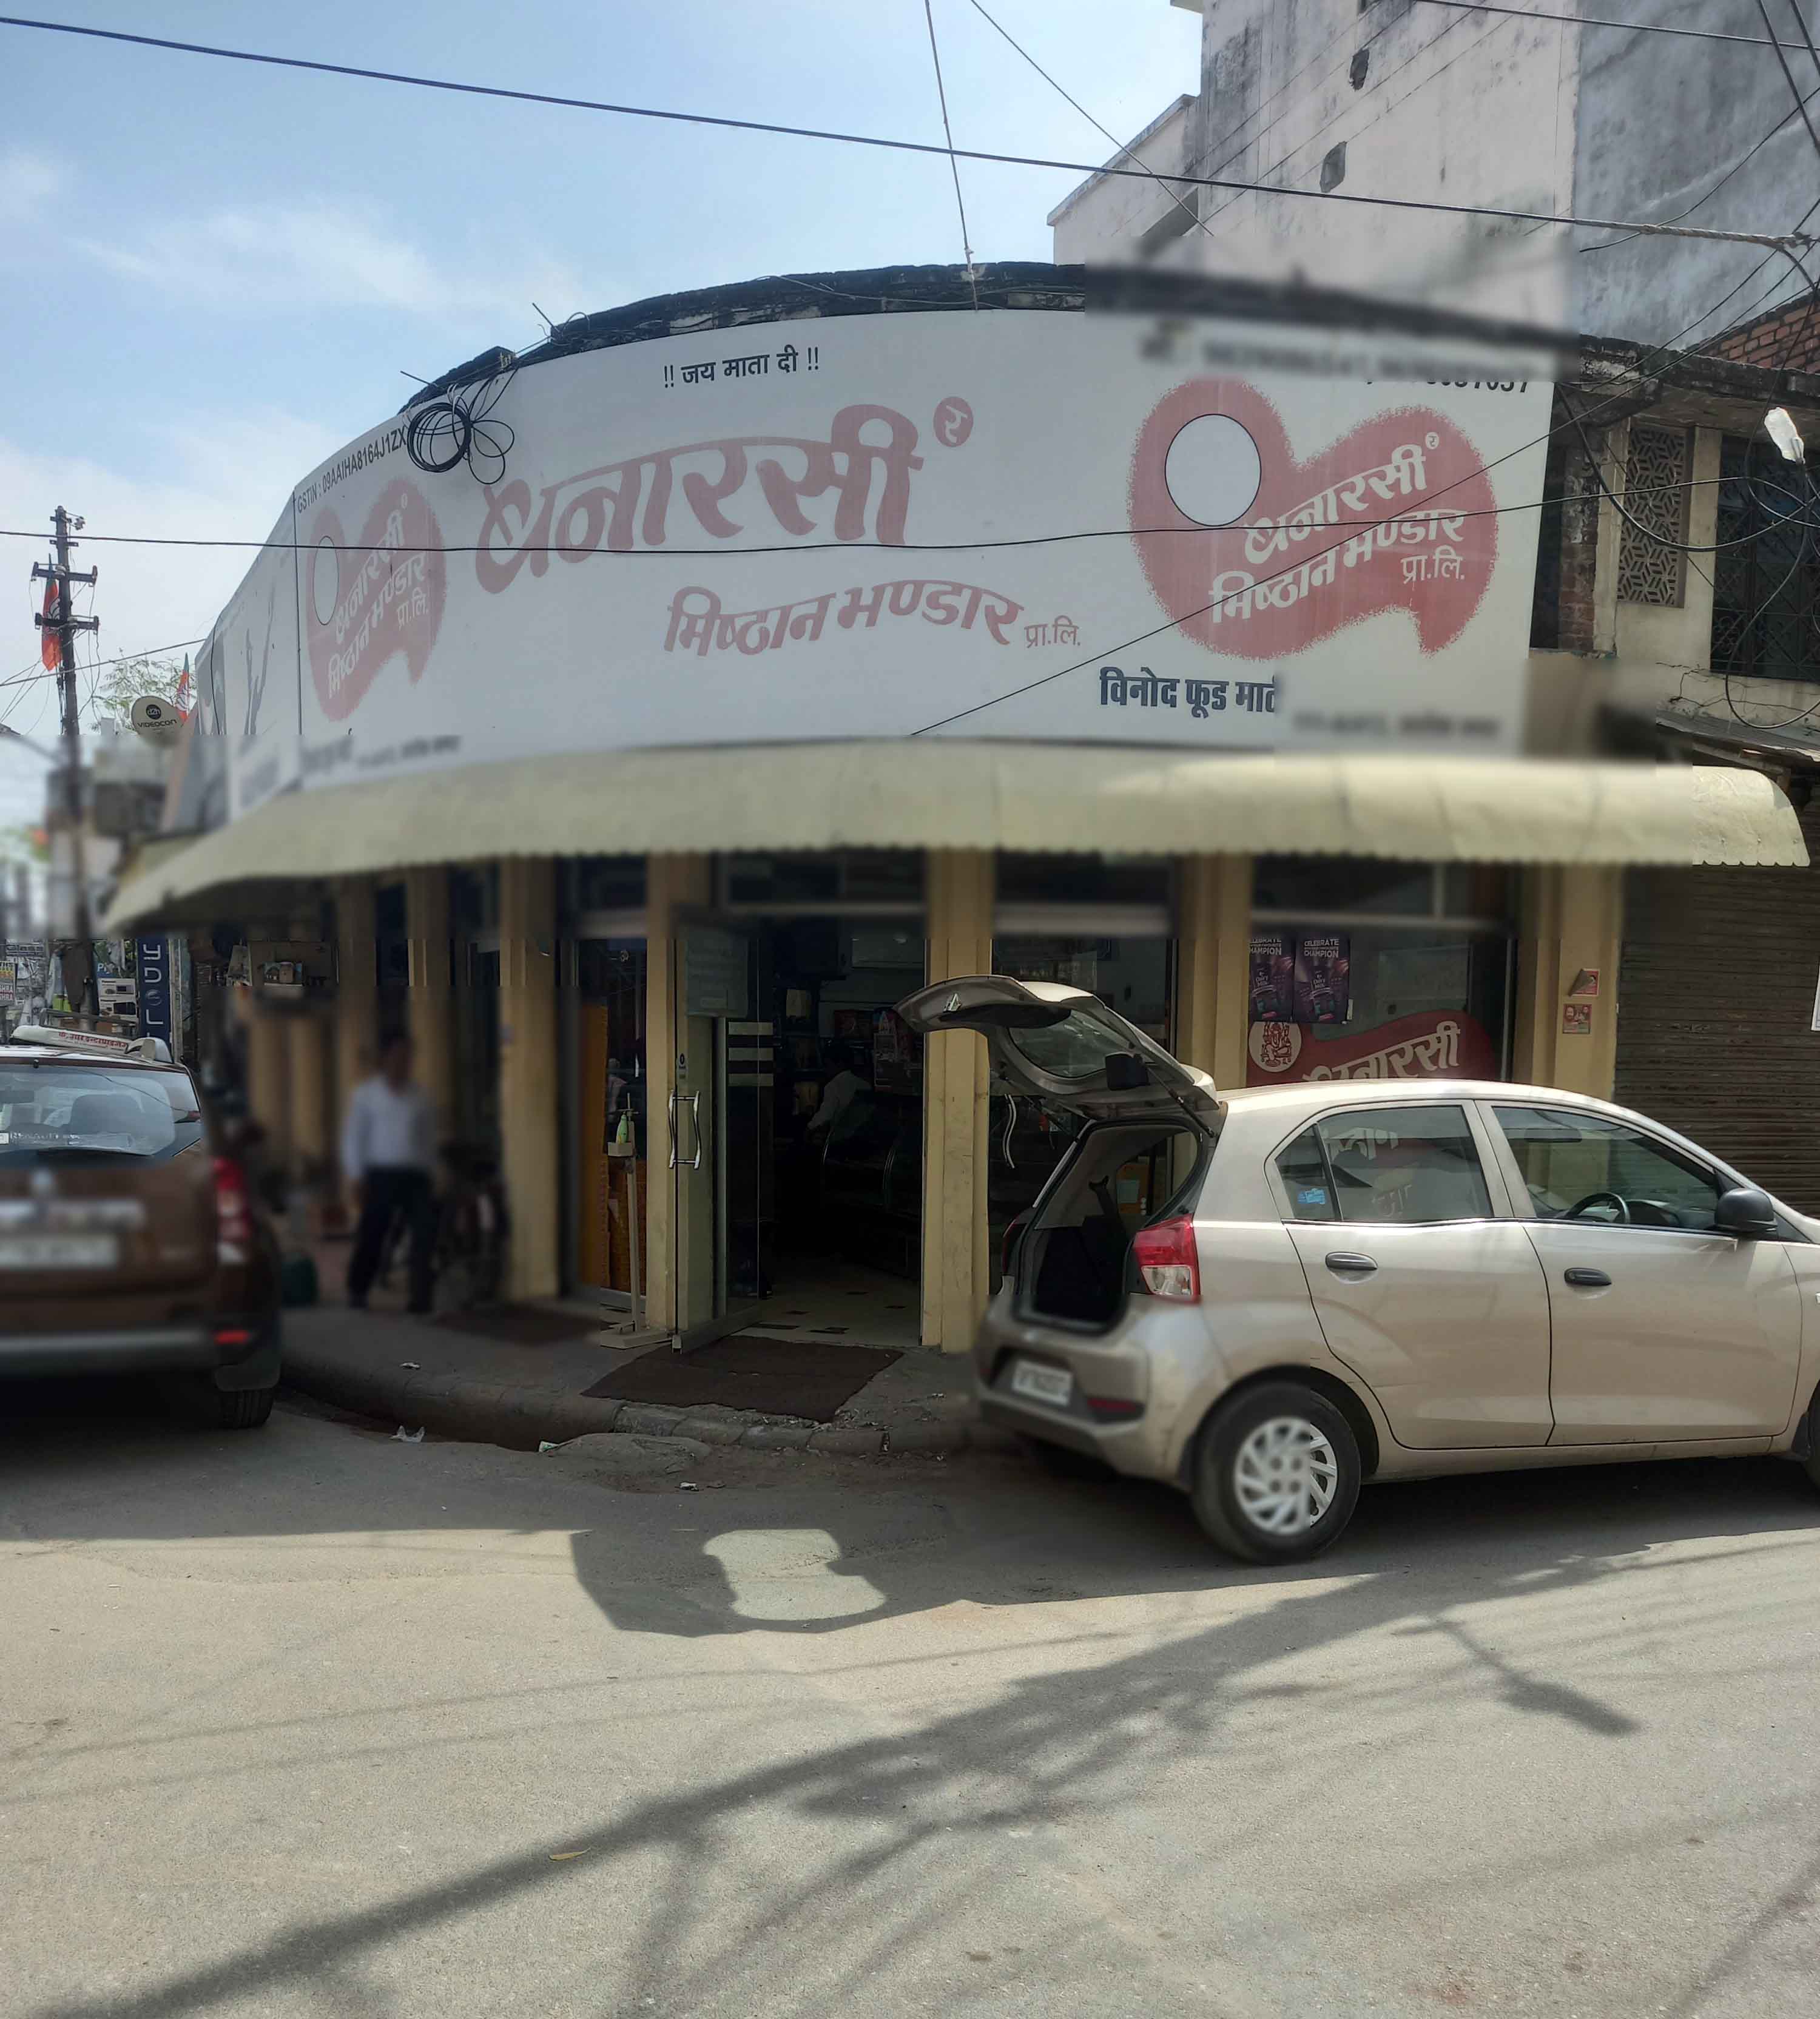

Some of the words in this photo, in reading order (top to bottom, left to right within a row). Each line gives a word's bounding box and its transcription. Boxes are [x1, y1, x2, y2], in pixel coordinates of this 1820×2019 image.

[681, 362, 716, 383] जय
[722, 354, 770, 377] माता
[776, 344, 799, 373] दी
[297, 484, 317, 513] GSTIN
[664, 586, 837, 657] मिष्ठान
[838, 579, 1024, 645] भण्डार
[1099, 666, 1180, 708] विनोद
[1185, 678, 1229, 719] फूड
[1304, 939, 1340, 947] CELEBRATE
[1304, 949, 1339, 958] CHAMPION
